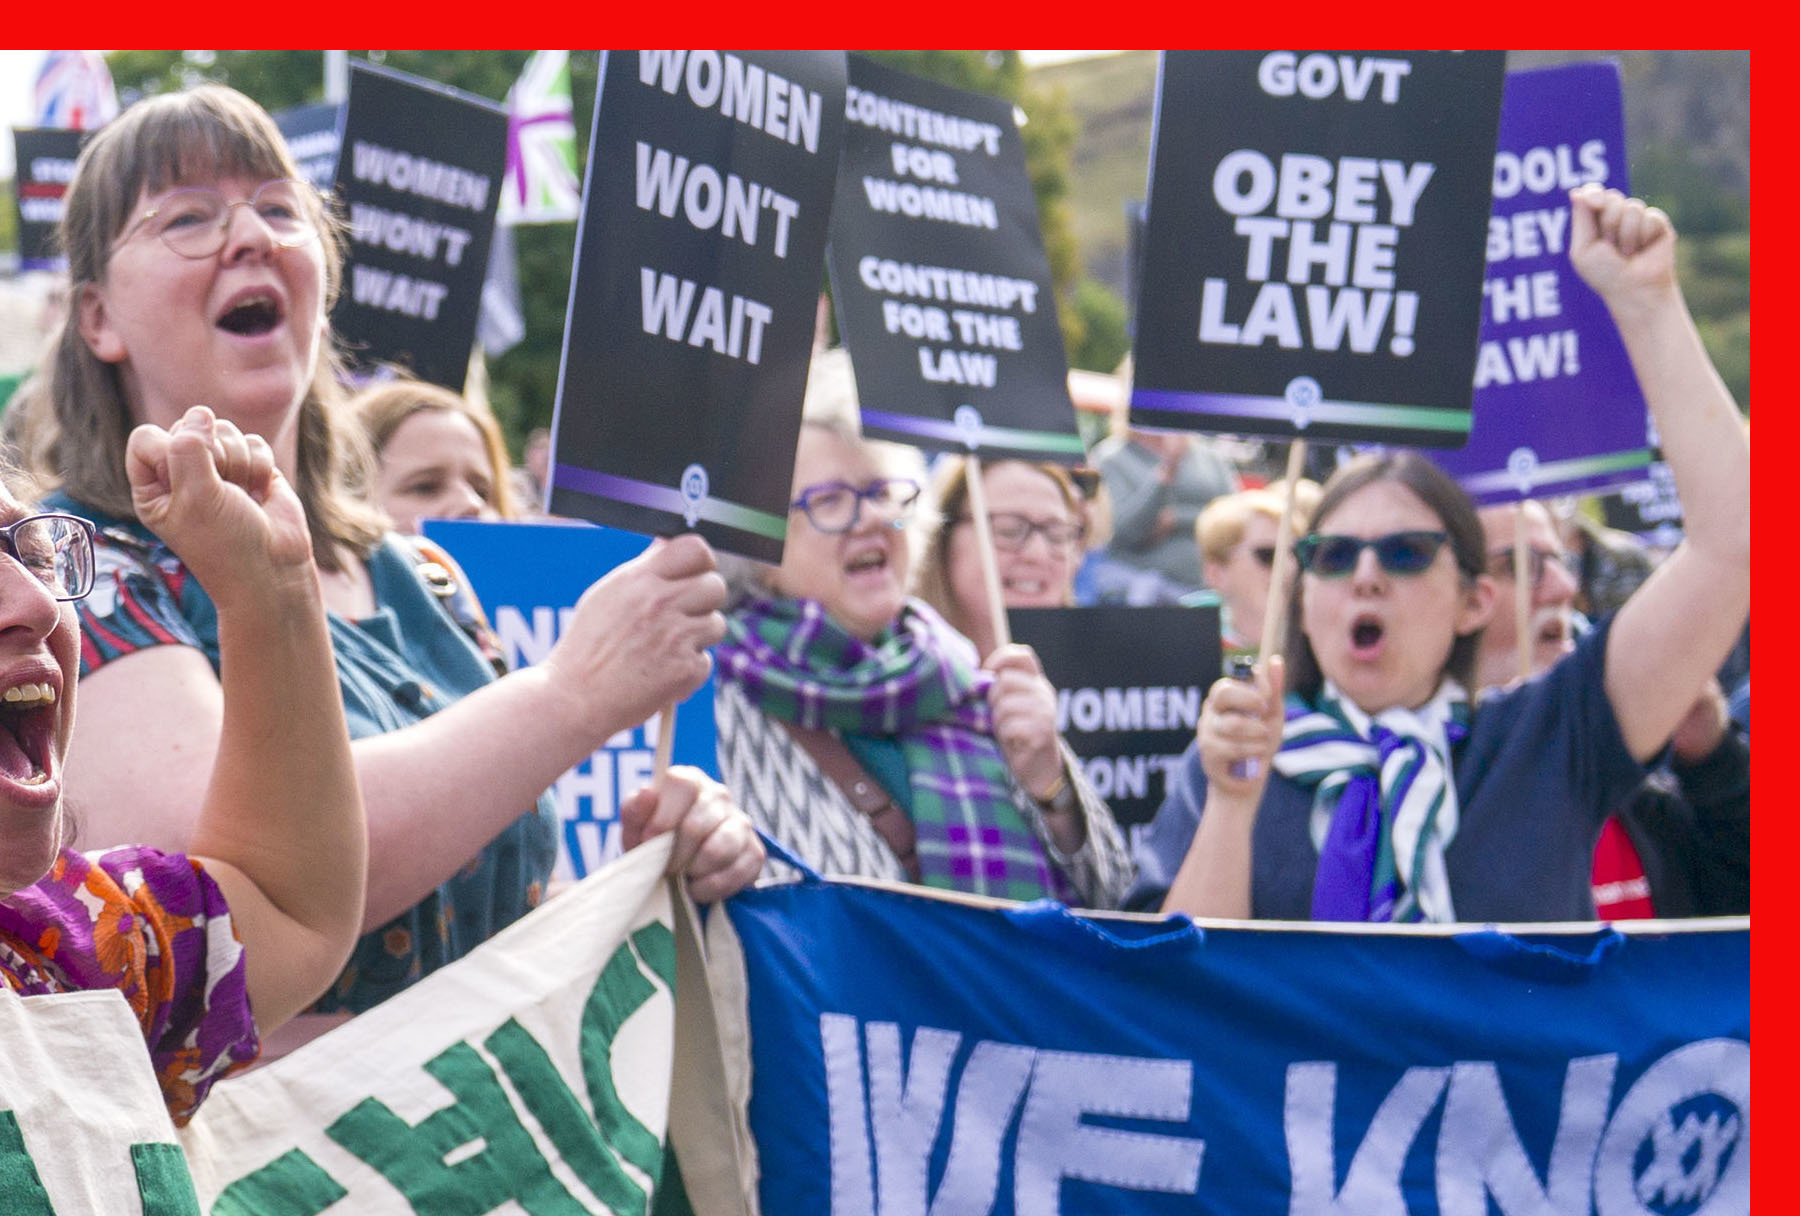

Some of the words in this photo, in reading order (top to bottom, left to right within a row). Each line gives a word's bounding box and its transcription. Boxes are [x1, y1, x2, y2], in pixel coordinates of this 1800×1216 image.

[639, 50, 822, 154] WOMEN
[1258, 50, 1412, 104] GOVT
[845, 84, 1001, 156] CONTEMPT
[352, 139, 491, 212] WOMEN
[891, 142, 959, 184] FOR
[1212, 149, 1437, 227] OBEY
[636, 140, 800, 260] WON'T
[862, 175, 999, 230] WOMEN
[349, 201, 472, 267] WON'T
[1234, 216, 1400, 290] THE
[352, 263, 449, 321] WAIT
[640, 266, 774, 366] WAIT
[858, 255, 1039, 313] CONTEMPT
[882, 299, 952, 341] FOR
[952, 311, 1024, 351] THE
[1198, 277, 1420, 358] LAW!
[918, 345, 998, 388] LAW
[1080, 755, 1187, 801] ON'T
